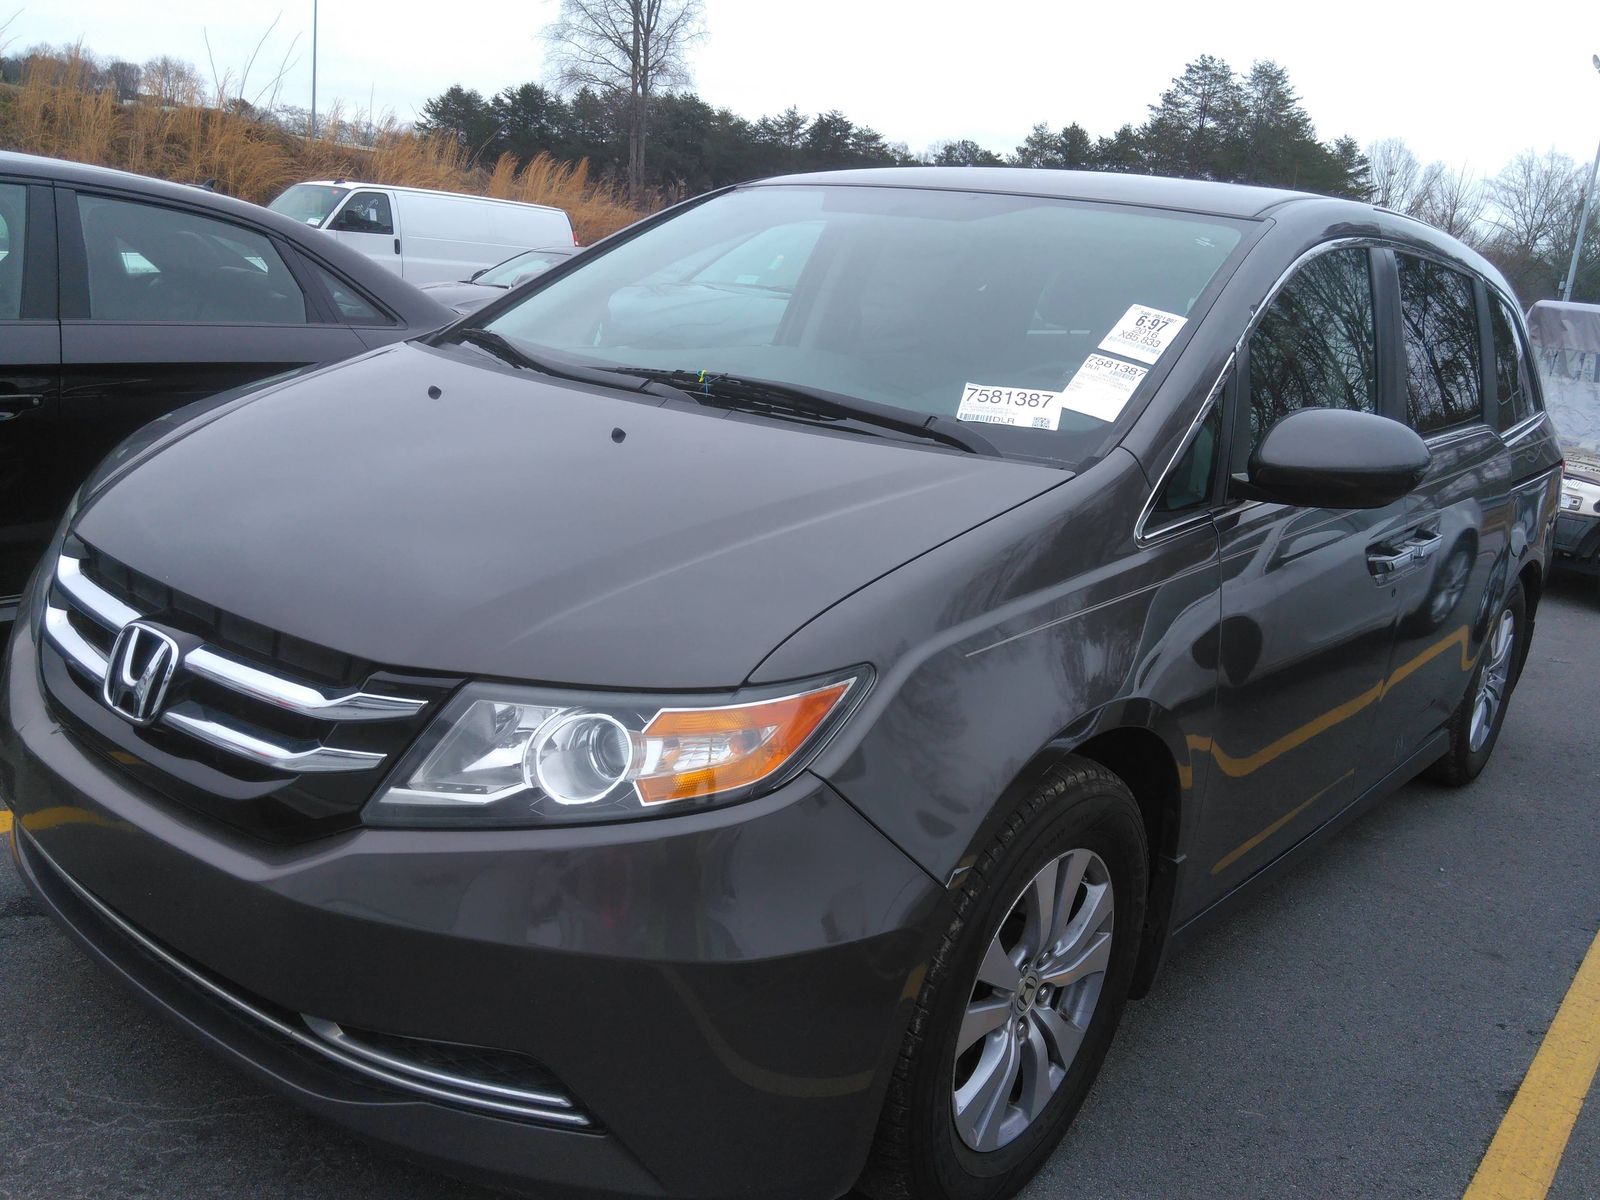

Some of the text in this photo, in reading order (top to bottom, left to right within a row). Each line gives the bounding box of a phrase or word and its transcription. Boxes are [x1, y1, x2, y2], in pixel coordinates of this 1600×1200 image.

[1133, 327, 1159, 338] 2016
[1085, 362, 1100, 371] DLR
[1088, 355, 1147, 377] 7581387
[966, 388, 1053, 408] 7581387
[992, 415, 1015, 424] DLR
